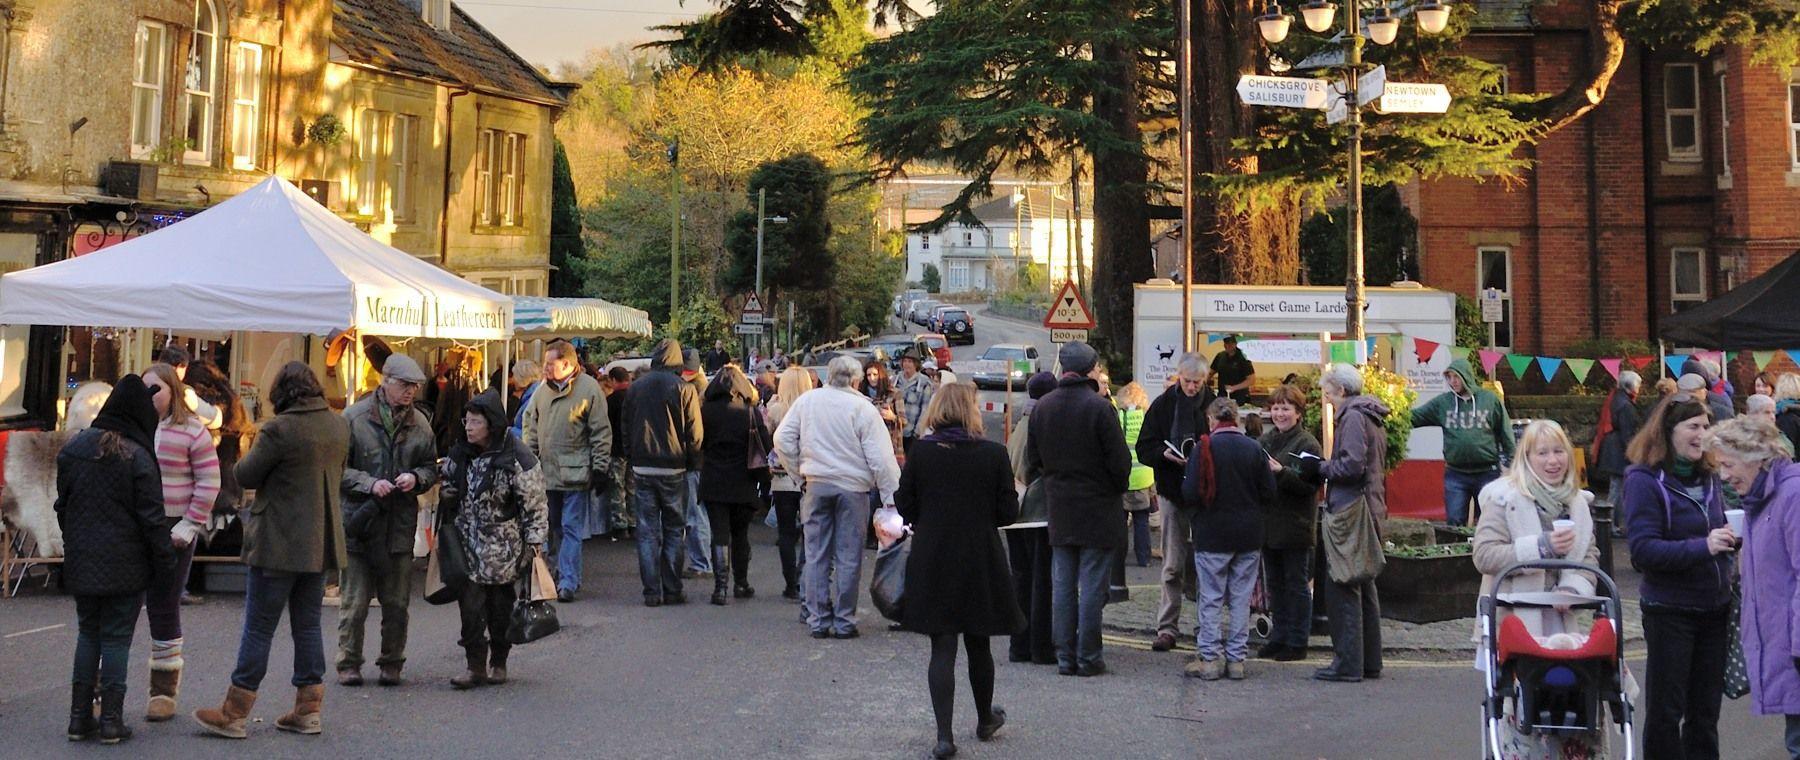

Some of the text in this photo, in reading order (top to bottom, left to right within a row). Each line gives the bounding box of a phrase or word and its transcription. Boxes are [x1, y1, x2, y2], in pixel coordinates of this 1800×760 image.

[1248, 79, 1320, 92] CHICKSGROVE
[1386, 86, 1436, 96] NEWTOWN
[1249, 92, 1305, 104] SALISBURY
[1214, 300, 1348, 313] The Dorset Game Larde
[435, 301, 506, 329] Leathercraft
